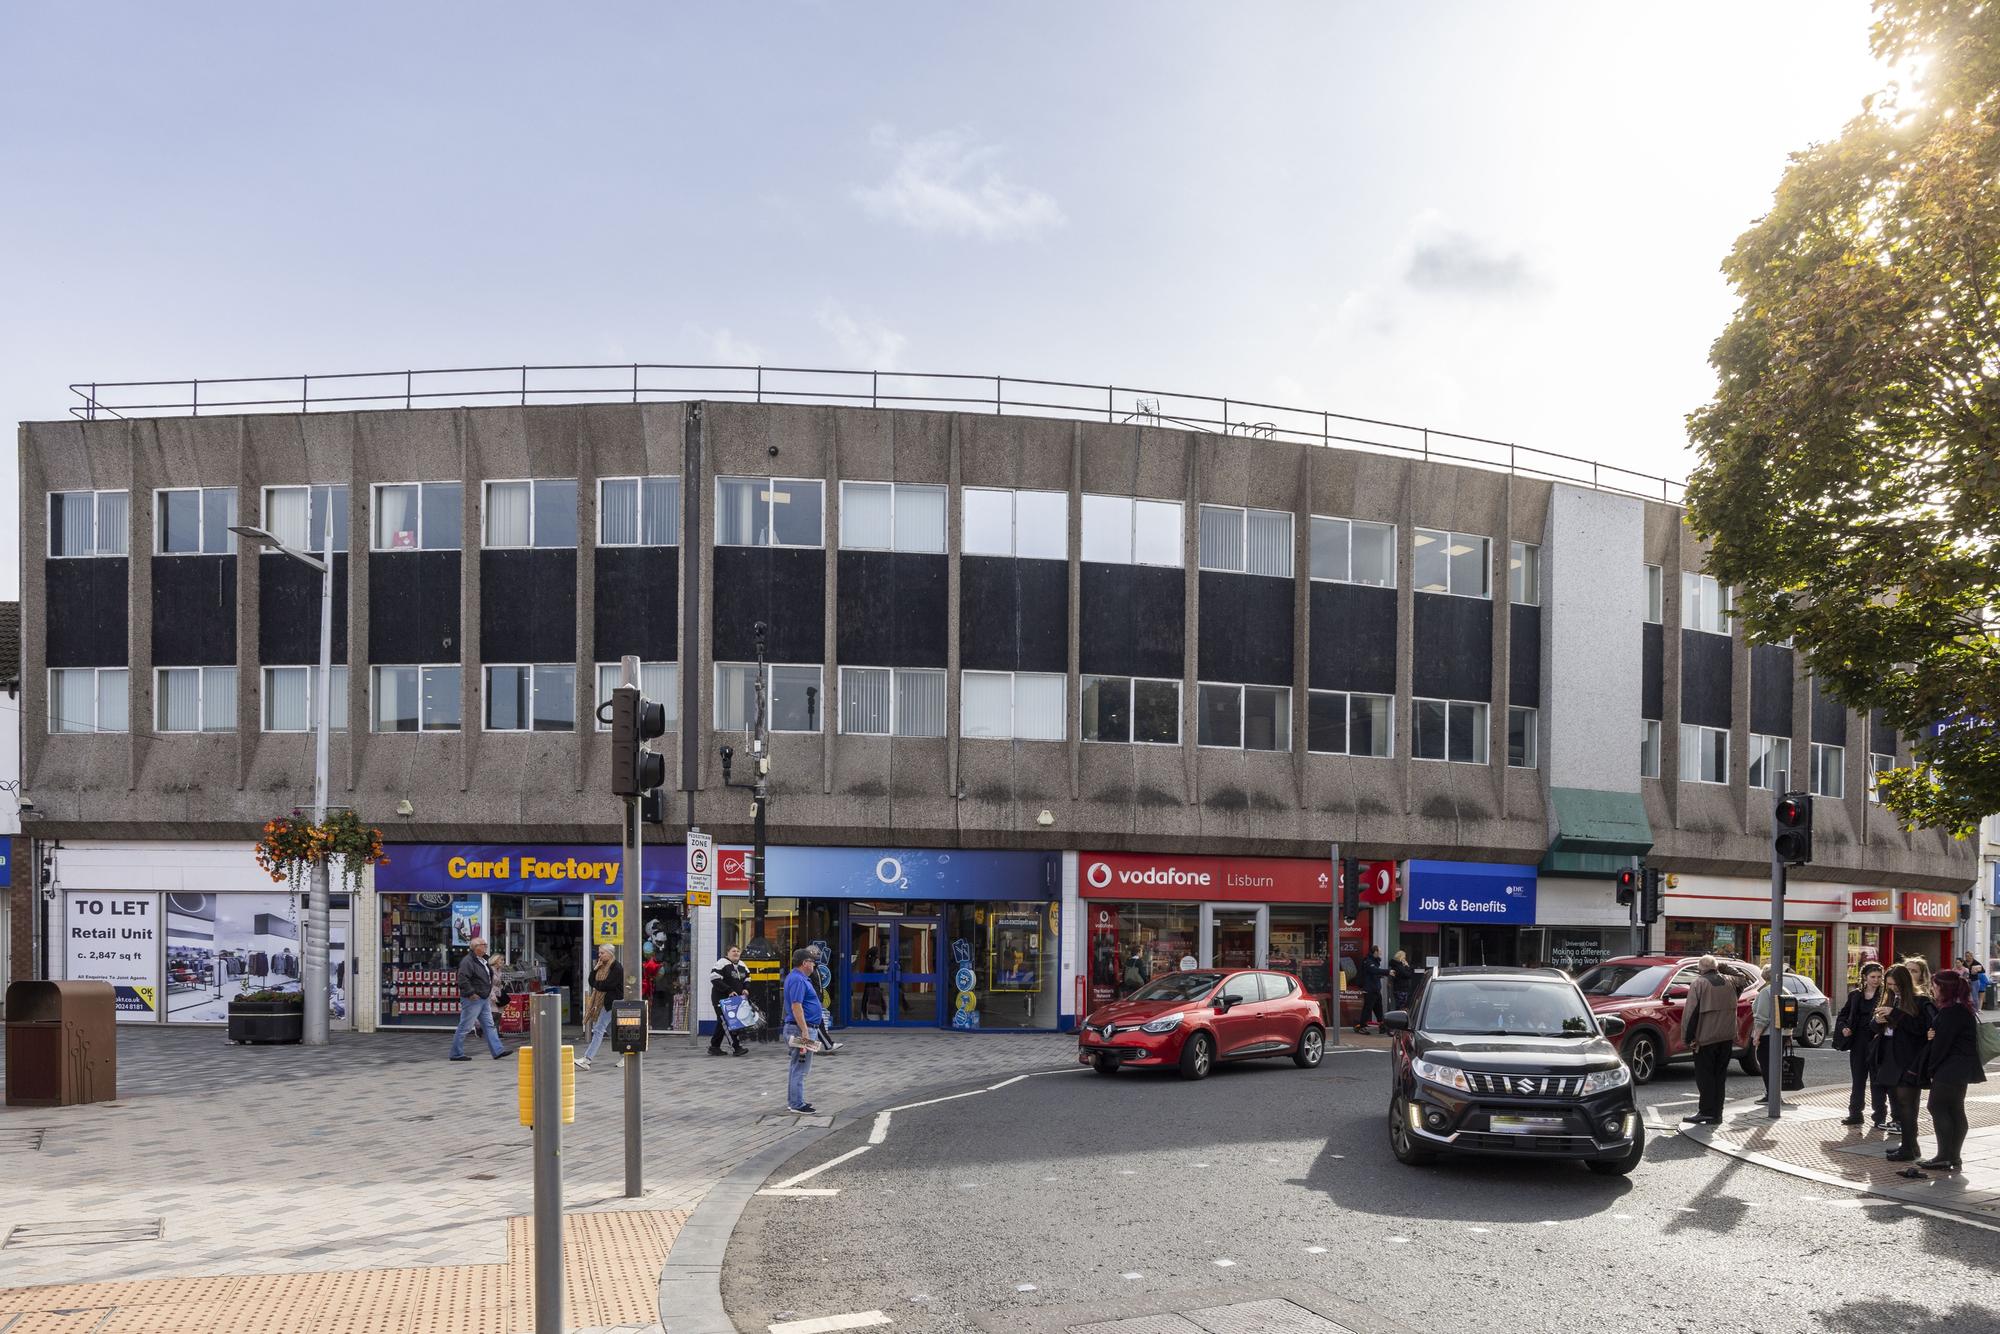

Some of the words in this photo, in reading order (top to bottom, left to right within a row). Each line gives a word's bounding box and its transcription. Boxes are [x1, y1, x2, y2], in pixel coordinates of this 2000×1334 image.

[691, 839, 708, 848] ZONE
[447, 856, 510, 879] Card
[520, 857, 620, 885] Factory
[876, 857, 909, 889] O2
[1118, 867, 1211, 886] vodafone
[1227, 874, 1274, 887] Lisburn
[75, 900, 104, 915] TO
[111, 901, 149, 915] LET
[1419, 898, 1445, 910] Jobs
[1448, 899, 1458, 911] &
[1461, 899, 1507, 913] Benefits
[1854, 897, 1888, 906] Iceland
[1913, 898, 1951, 917] Iceland
[600, 904, 618, 918] 10
[72, 927, 116, 938] Retail
[121, 928, 152, 939] Unit
[601, 921, 617, 935] £1
[89, 951, 116, 960] 2,847
[119, 953, 131, 961] sq
[134, 952, 141, 960] ft
[1552, 948, 1574, 956] Making
[1552, 957, 1559, 965] by
